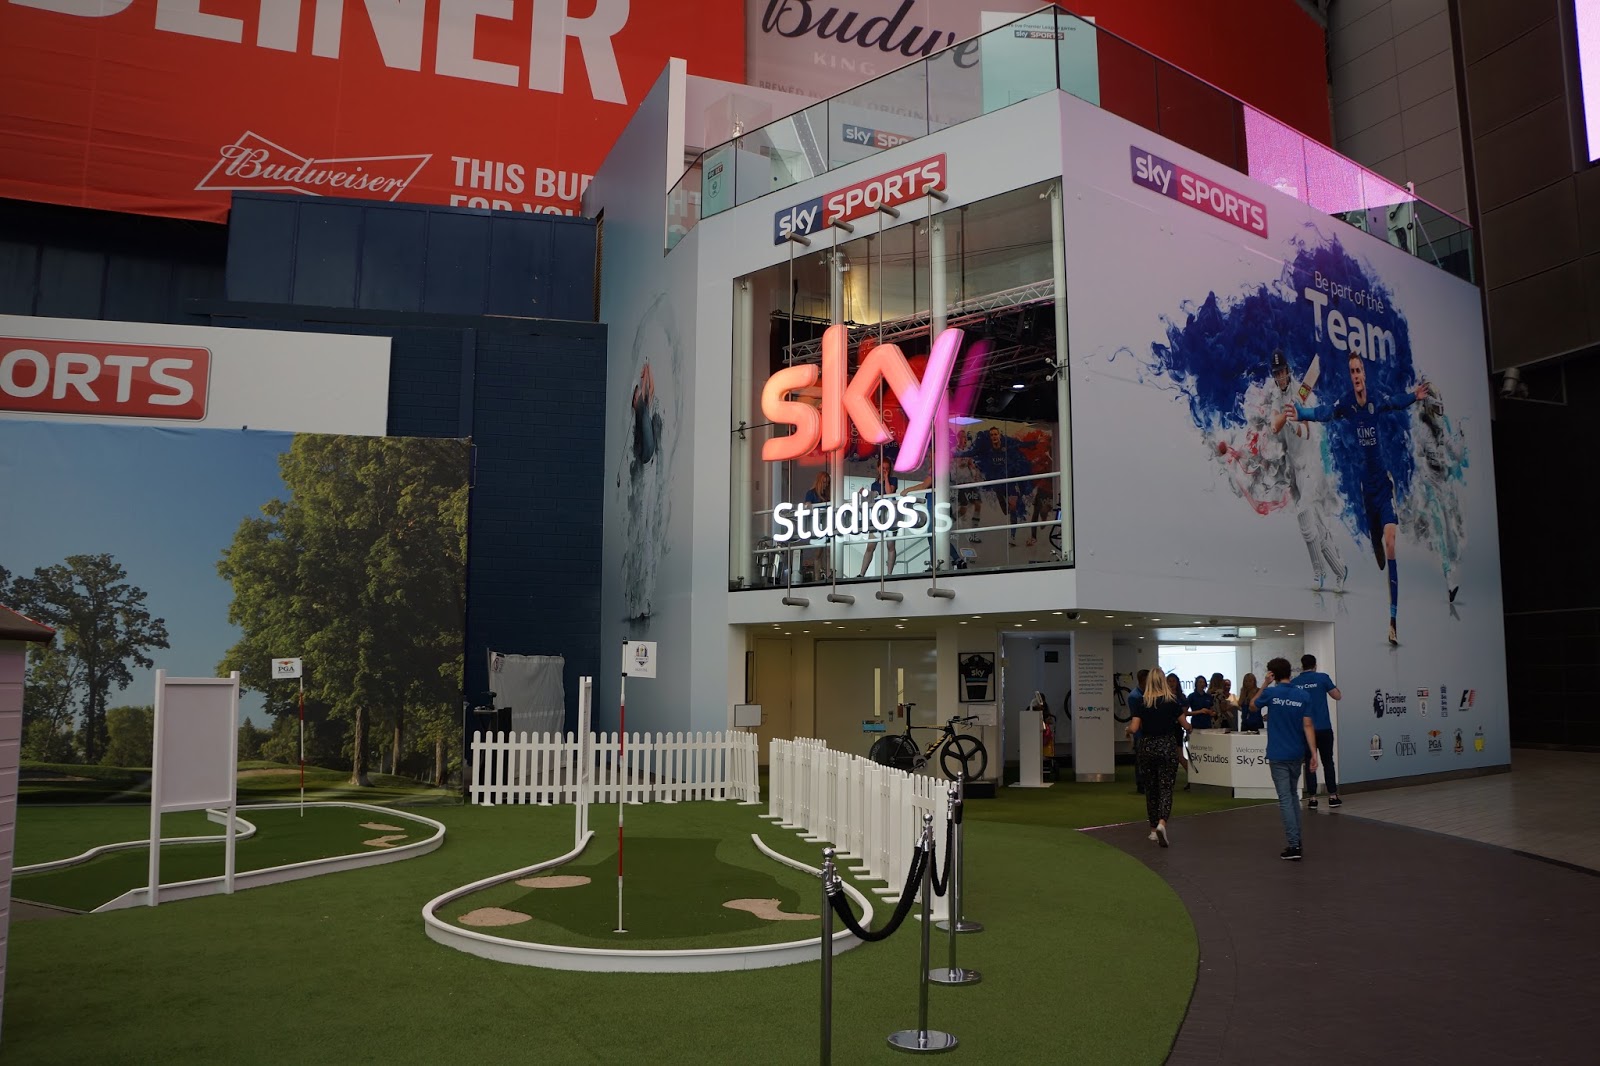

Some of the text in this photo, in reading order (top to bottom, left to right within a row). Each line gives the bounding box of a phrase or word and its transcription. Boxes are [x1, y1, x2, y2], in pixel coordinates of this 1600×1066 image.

[1015, 30, 1028, 38] sky
[814, 52, 876, 76] KING
[846, 127, 871, 145] sky
[220, 144, 407, 193] Budweiser
[450, 156, 525, 194] THIS
[779, 161, 941, 239] sky SPORTS
[1135, 155, 1265, 231] sky SPORTS
[1314, 270, 1384, 314] Be part of the
[1304, 287, 1396, 364] Team
[761, 324, 966, 473] sky
[1356, 425, 1376, 439] KING
[1358, 436, 1377, 447] POWER
[773, 489, 919, 542] Studios
[971, 668, 985, 677] sky
[1272, 697, 1303, 708] Sky Crew
[1385, 692, 1407, 704] Premier
[1385, 704, 1407, 717] League
[1395, 742, 1417, 757] OPEN
[1428, 739, 1442, 749] PGA
[1190, 752, 1229, 764] Sky Studios
[1236, 755, 1255, 767] Sky
